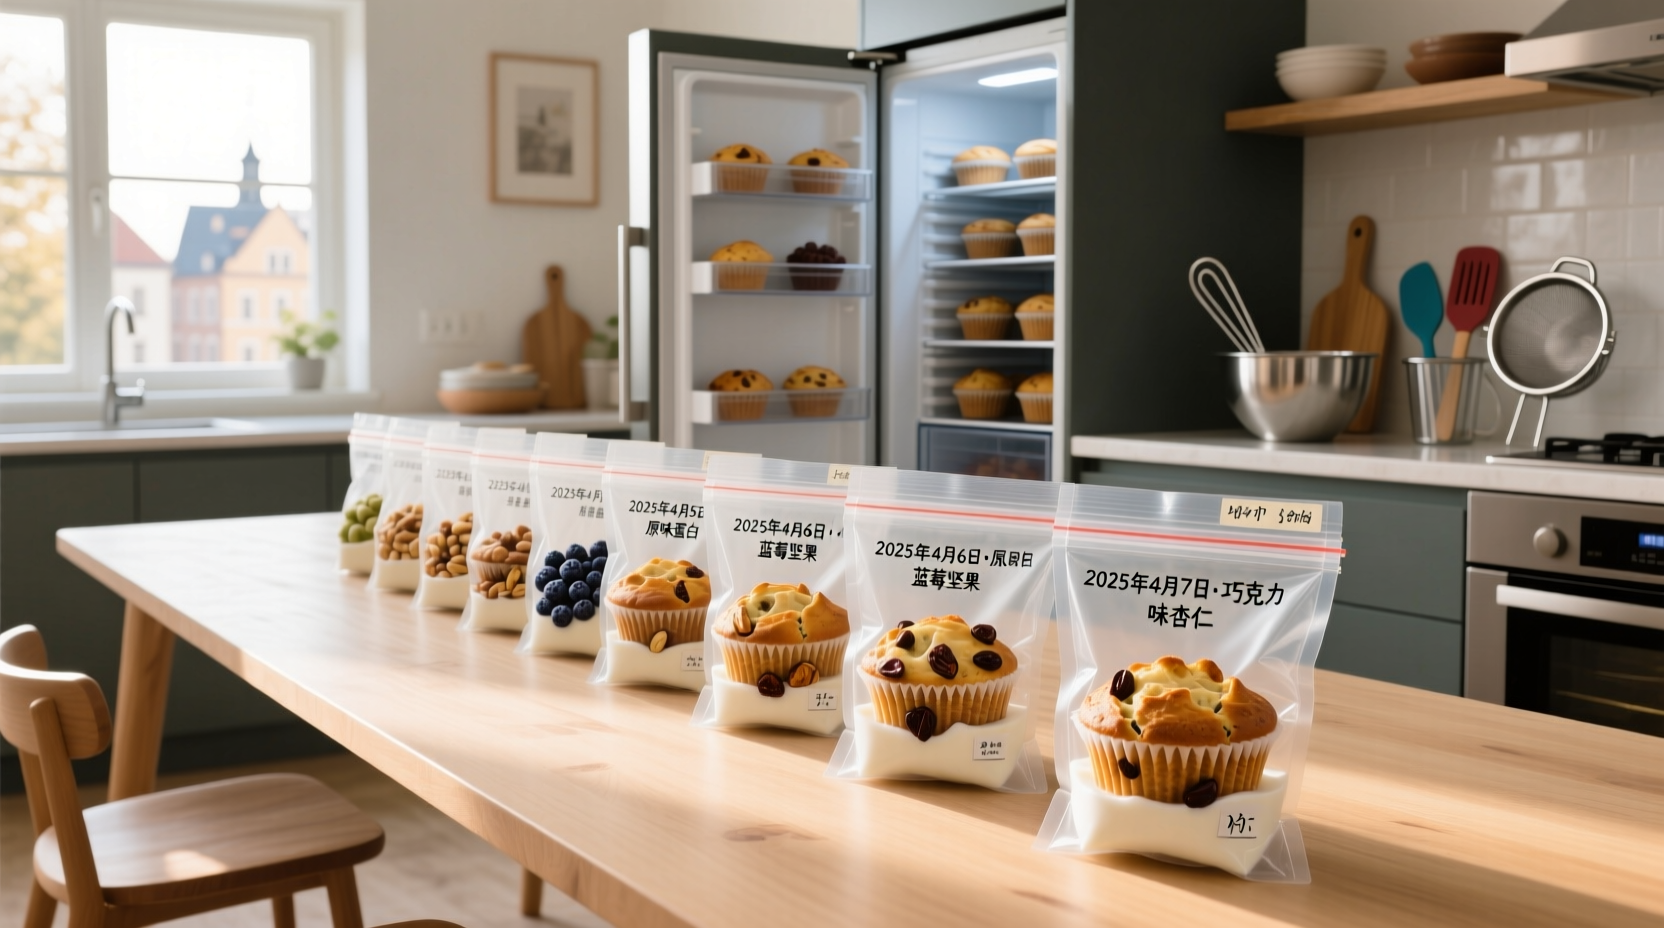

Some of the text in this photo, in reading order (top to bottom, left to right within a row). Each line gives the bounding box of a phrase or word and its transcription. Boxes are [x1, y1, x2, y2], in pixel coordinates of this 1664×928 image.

[911, 566, 981, 592] 蓝莓坚果
[1083, 569, 1285, 606] 2025年4月7日·巧克力
[1147, 602, 1214, 629] 味杏仁
